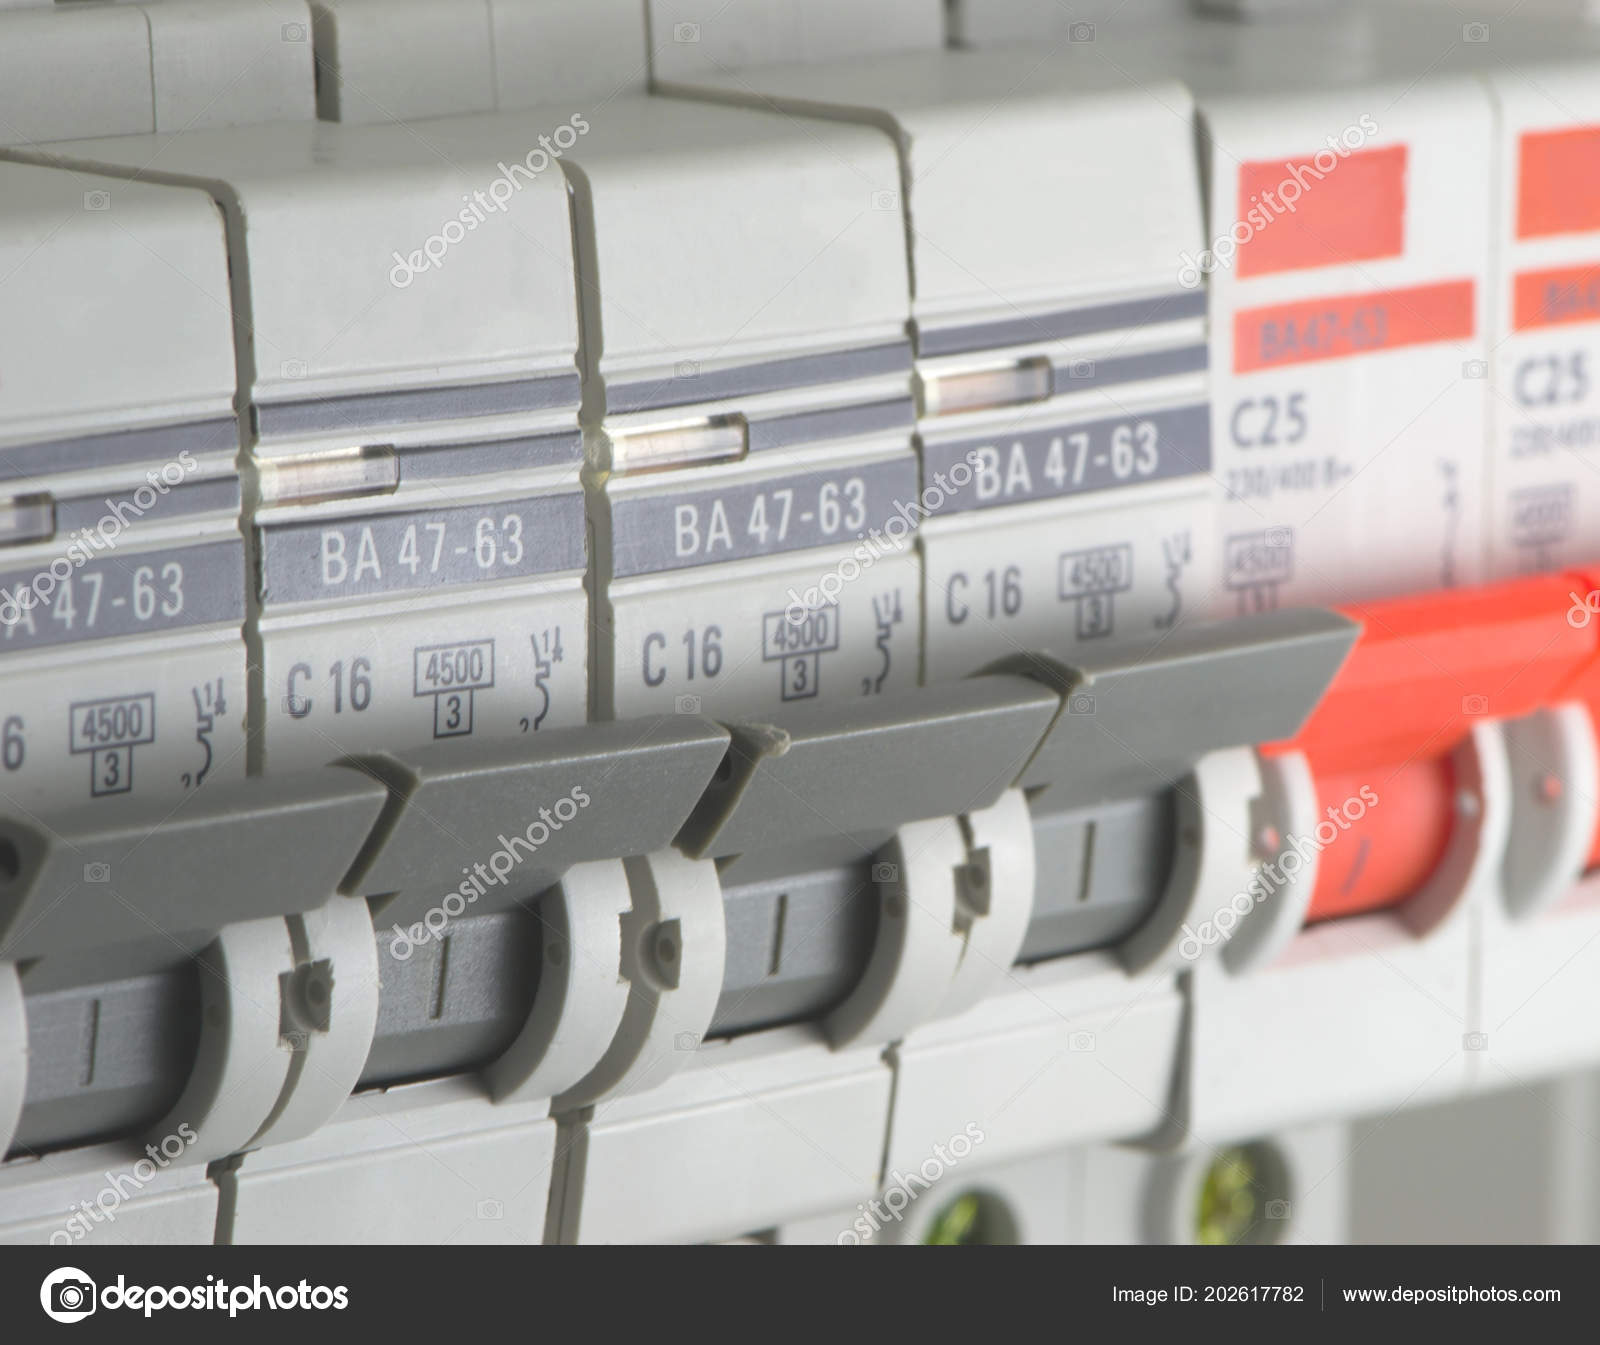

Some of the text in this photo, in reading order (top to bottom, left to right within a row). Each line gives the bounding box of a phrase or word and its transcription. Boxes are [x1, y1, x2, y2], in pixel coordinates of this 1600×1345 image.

[1230, 391, 1309, 449] C25
[1043, 423, 1159, 488] 47-63
[675, 478, 867, 558] BA 47-63
[321, 514, 524, 586] BA 47-63
[1070, 553, 1122, 587] 4500
[53, 562, 184, 630] 47-63
[946, 572, 969, 626] C
[985, 566, 1022, 619] 16
[642, 625, 723, 688] C 16
[773, 613, 829, 651] 4500
[287, 657, 372, 719] C 16
[425, 646, 484, 687] 4500
[792, 660, 808, 693] 3
[82, 702, 143, 743] 4500
[445, 697, 462, 730] 3
[104, 751, 120, 788] 3
